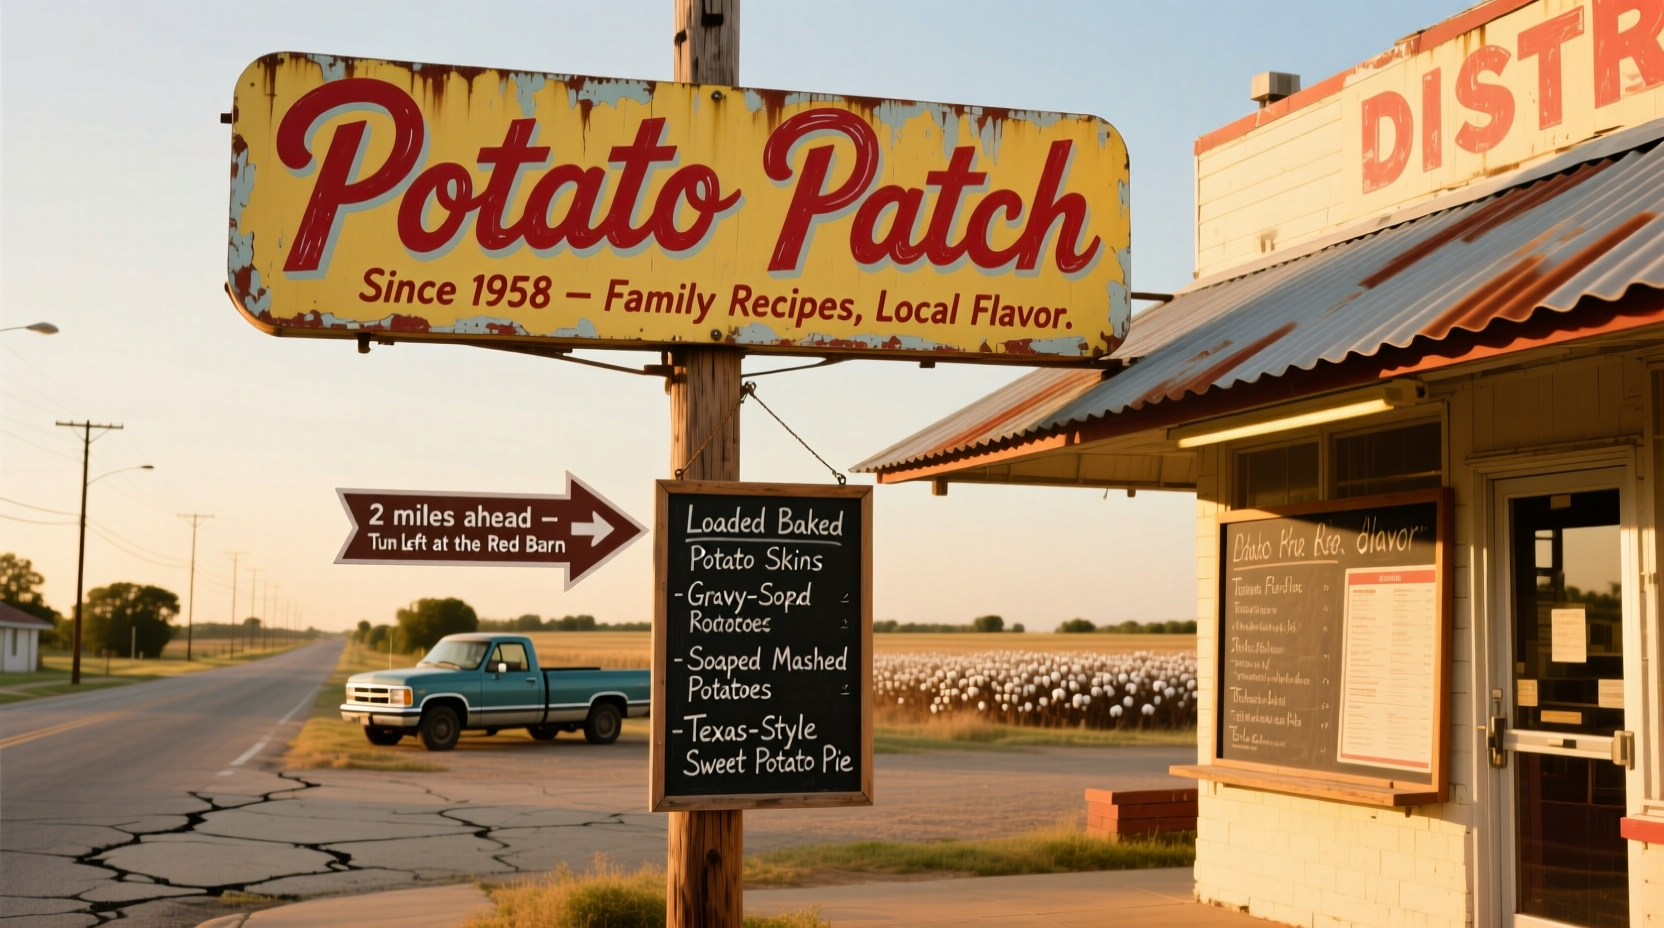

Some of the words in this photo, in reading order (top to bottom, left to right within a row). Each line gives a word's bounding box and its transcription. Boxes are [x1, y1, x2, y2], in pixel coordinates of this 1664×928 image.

[1361, 0, 1664, 195] DISTR
[276, 77, 741, 272] Potato
[762, 107, 1101, 274] Patch
[359, 267, 457, 305] Since
[471, 273, 553, 310] 1958
[604, 278, 717, 325] Family
[728, 284, 863, 328] Recipes,
[875, 289, 961, 325] Local
[970, 293, 1073, 330] Flavor.
[368, 502, 385, 526] 2
[393, 503, 455, 527] miles
[464, 504, 532, 529] ahead
[686, 503, 766, 534] Loaded
[777, 506, 844, 536] Baked
[432, 535, 449, 552] at
[453, 533, 481, 553] the
[487, 534, 520, 554] Red
[525, 535, 566, 554] Barn
[690, 544, 755, 572] Potato
[764, 546, 823, 572] Skins
[772, 645, 848, 672] Mashed
[688, 675, 772, 703] Potatoes
[683, 749, 747, 777] Sweet
[755, 746, 815, 775] Potato
[822, 744, 853, 774] Pie
